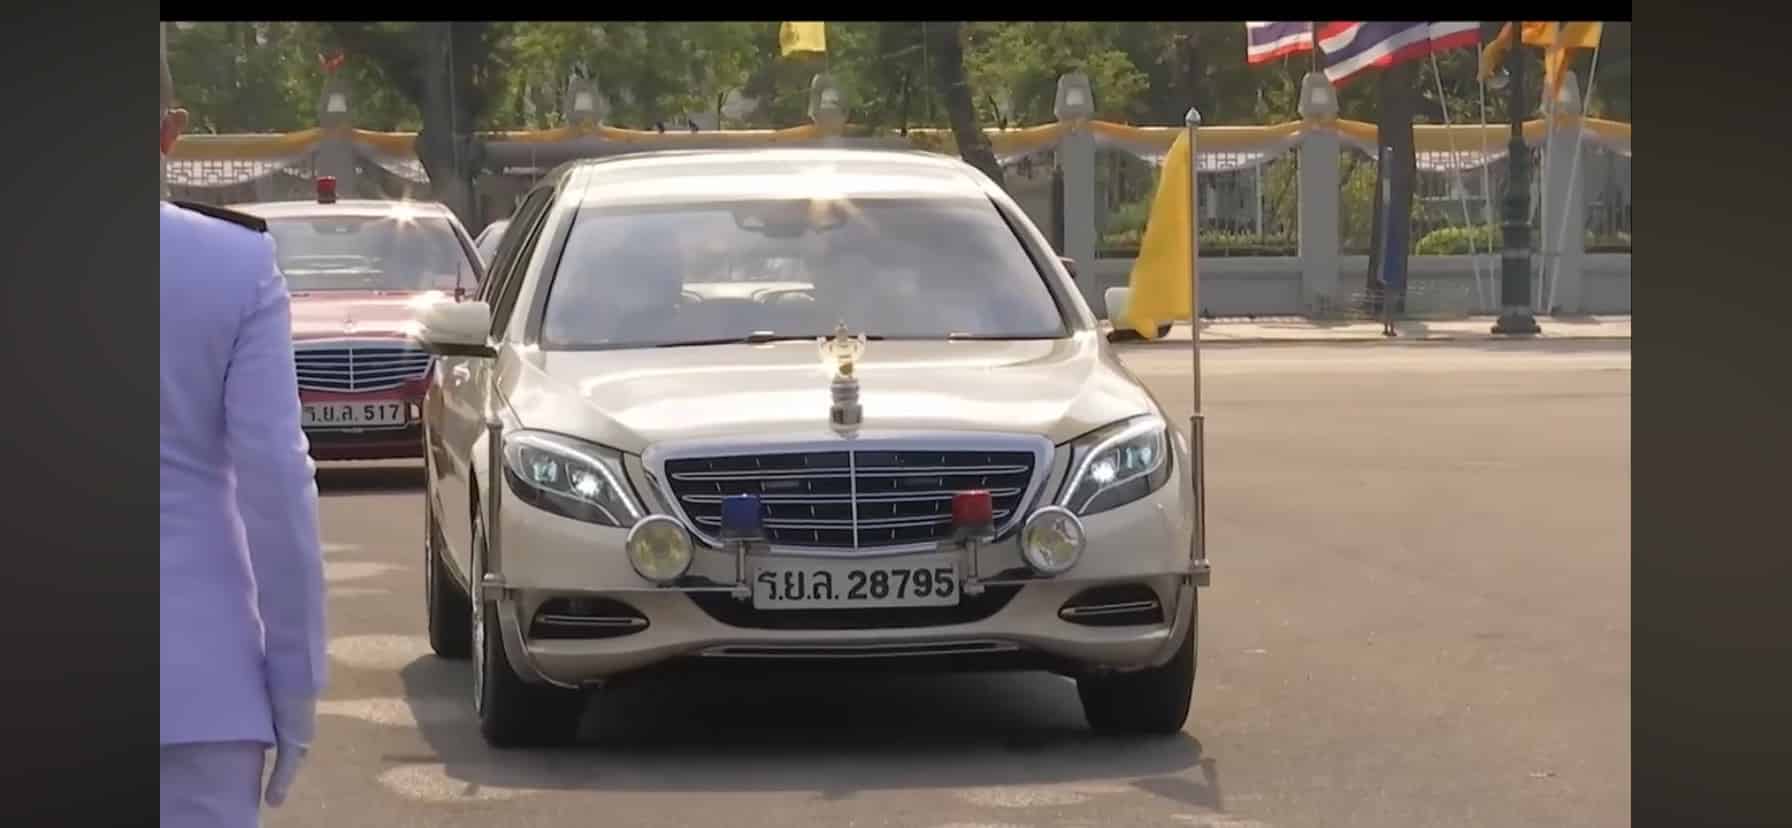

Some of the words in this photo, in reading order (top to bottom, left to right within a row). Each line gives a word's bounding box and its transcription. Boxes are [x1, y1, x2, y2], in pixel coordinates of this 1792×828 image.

[364, 404, 399, 421] 517
[757, 569, 839, 601] ร.ย.ล.
[847, 568, 954, 599] 28795
